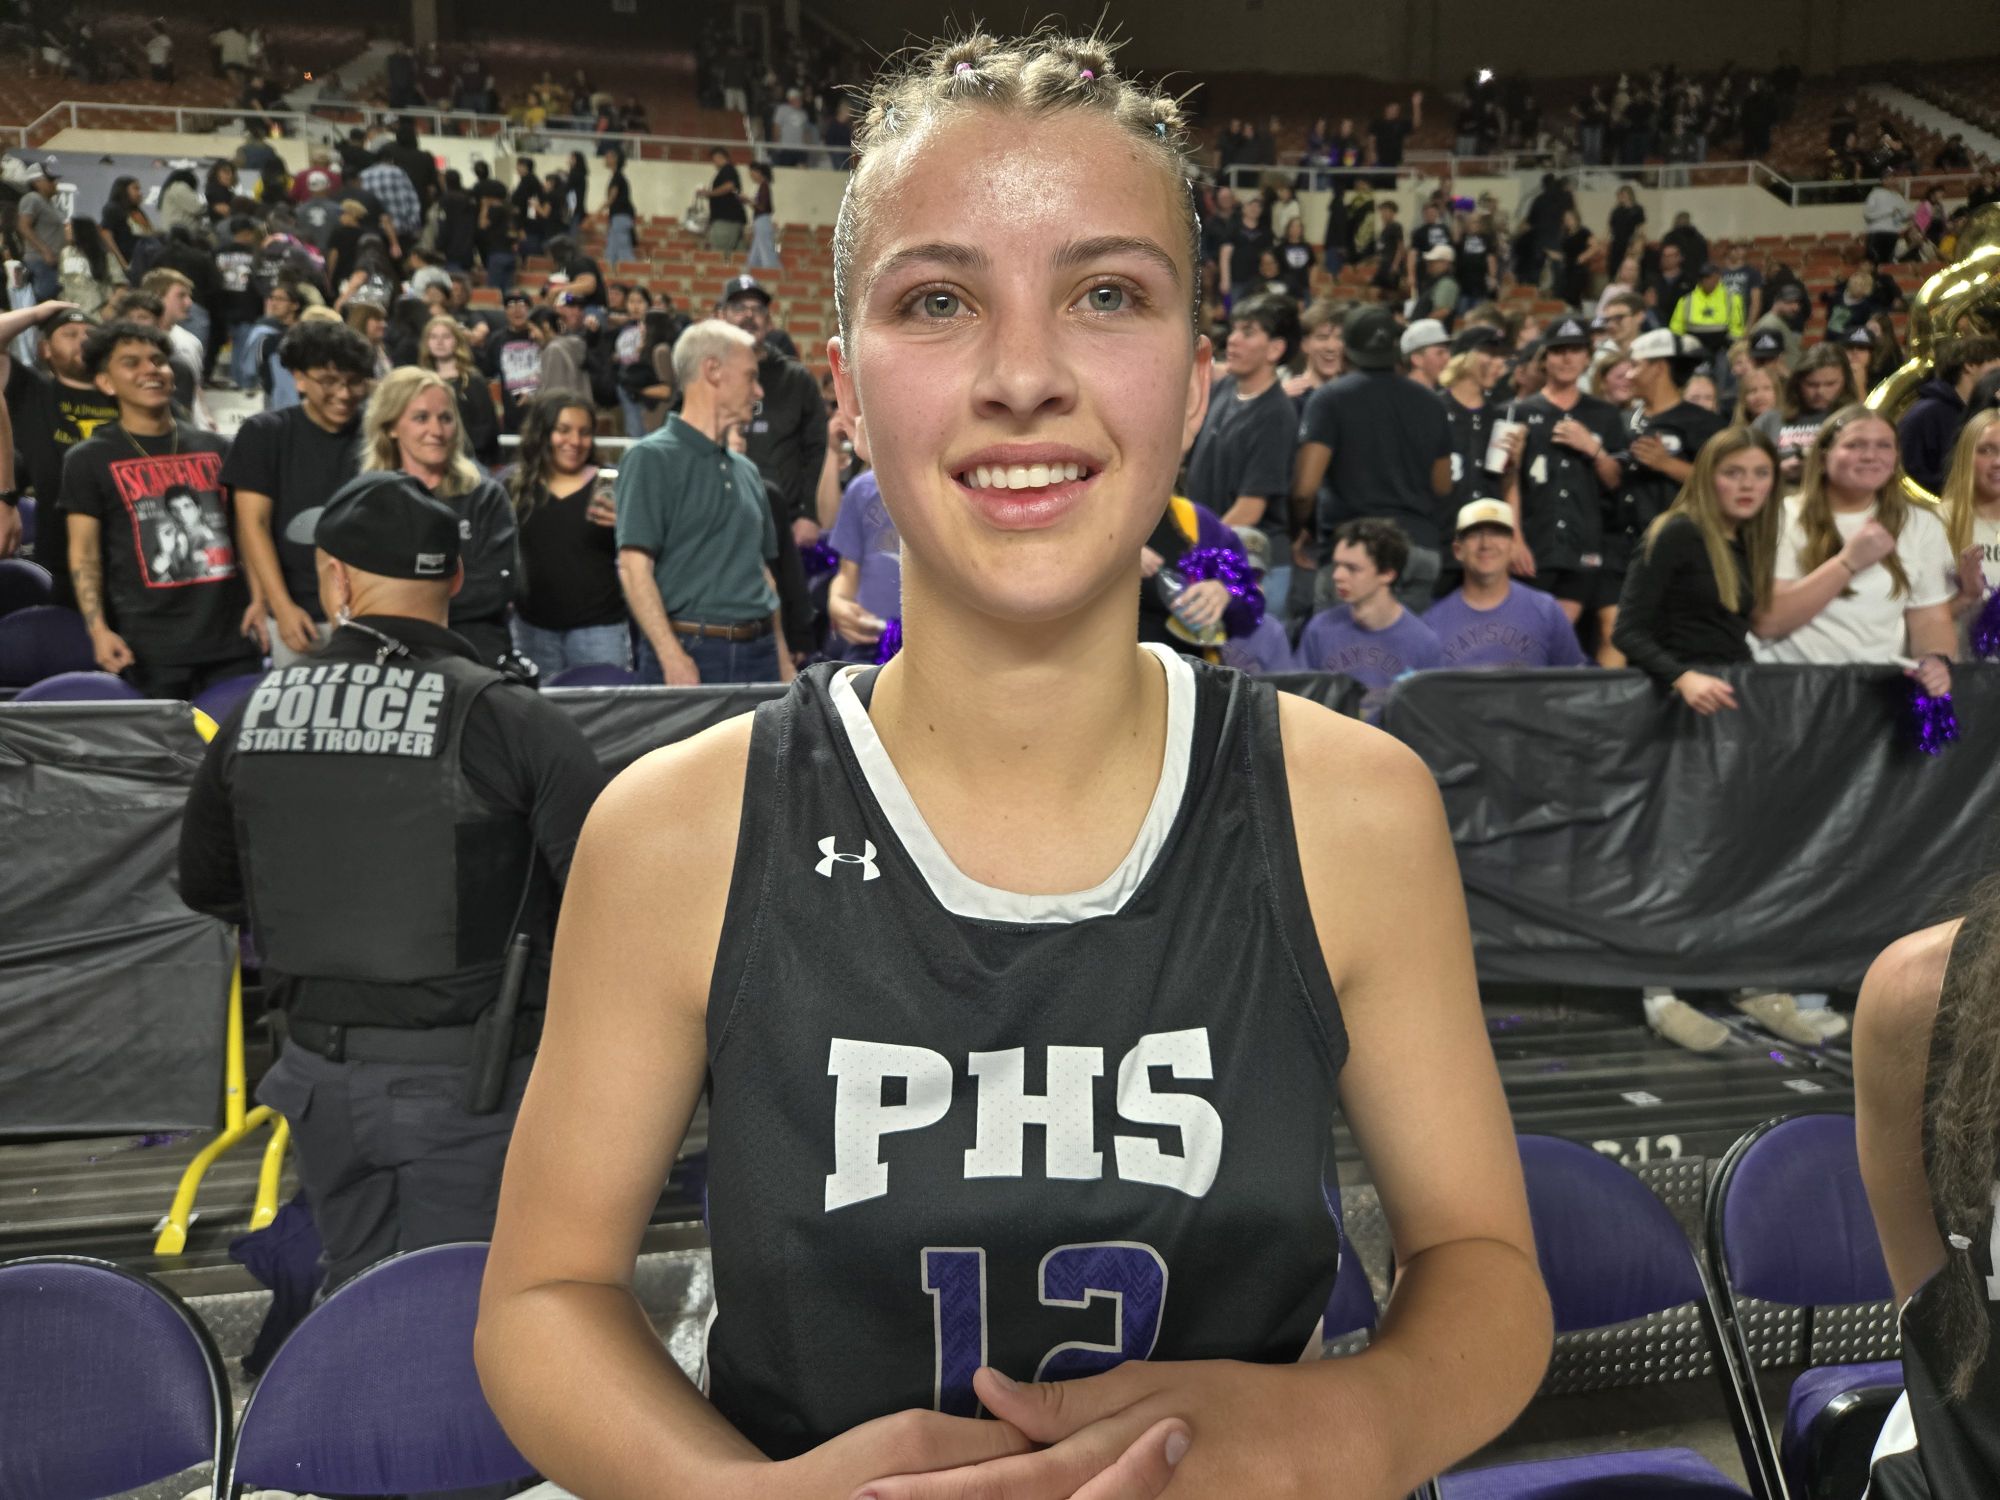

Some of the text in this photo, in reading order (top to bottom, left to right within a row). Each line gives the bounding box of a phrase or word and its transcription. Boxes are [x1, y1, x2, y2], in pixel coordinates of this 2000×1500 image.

[1325, 646, 1402, 676] PAYSO
[1444, 622, 1538, 662] PAYSON
[259, 662, 445, 693] ARIZONA
[242, 684, 445, 734] POLICE
[237, 728, 435, 757] STATE TROOPER
[824, 1027, 1223, 1212] PHS
[920, 1240, 1170, 1418] 12
